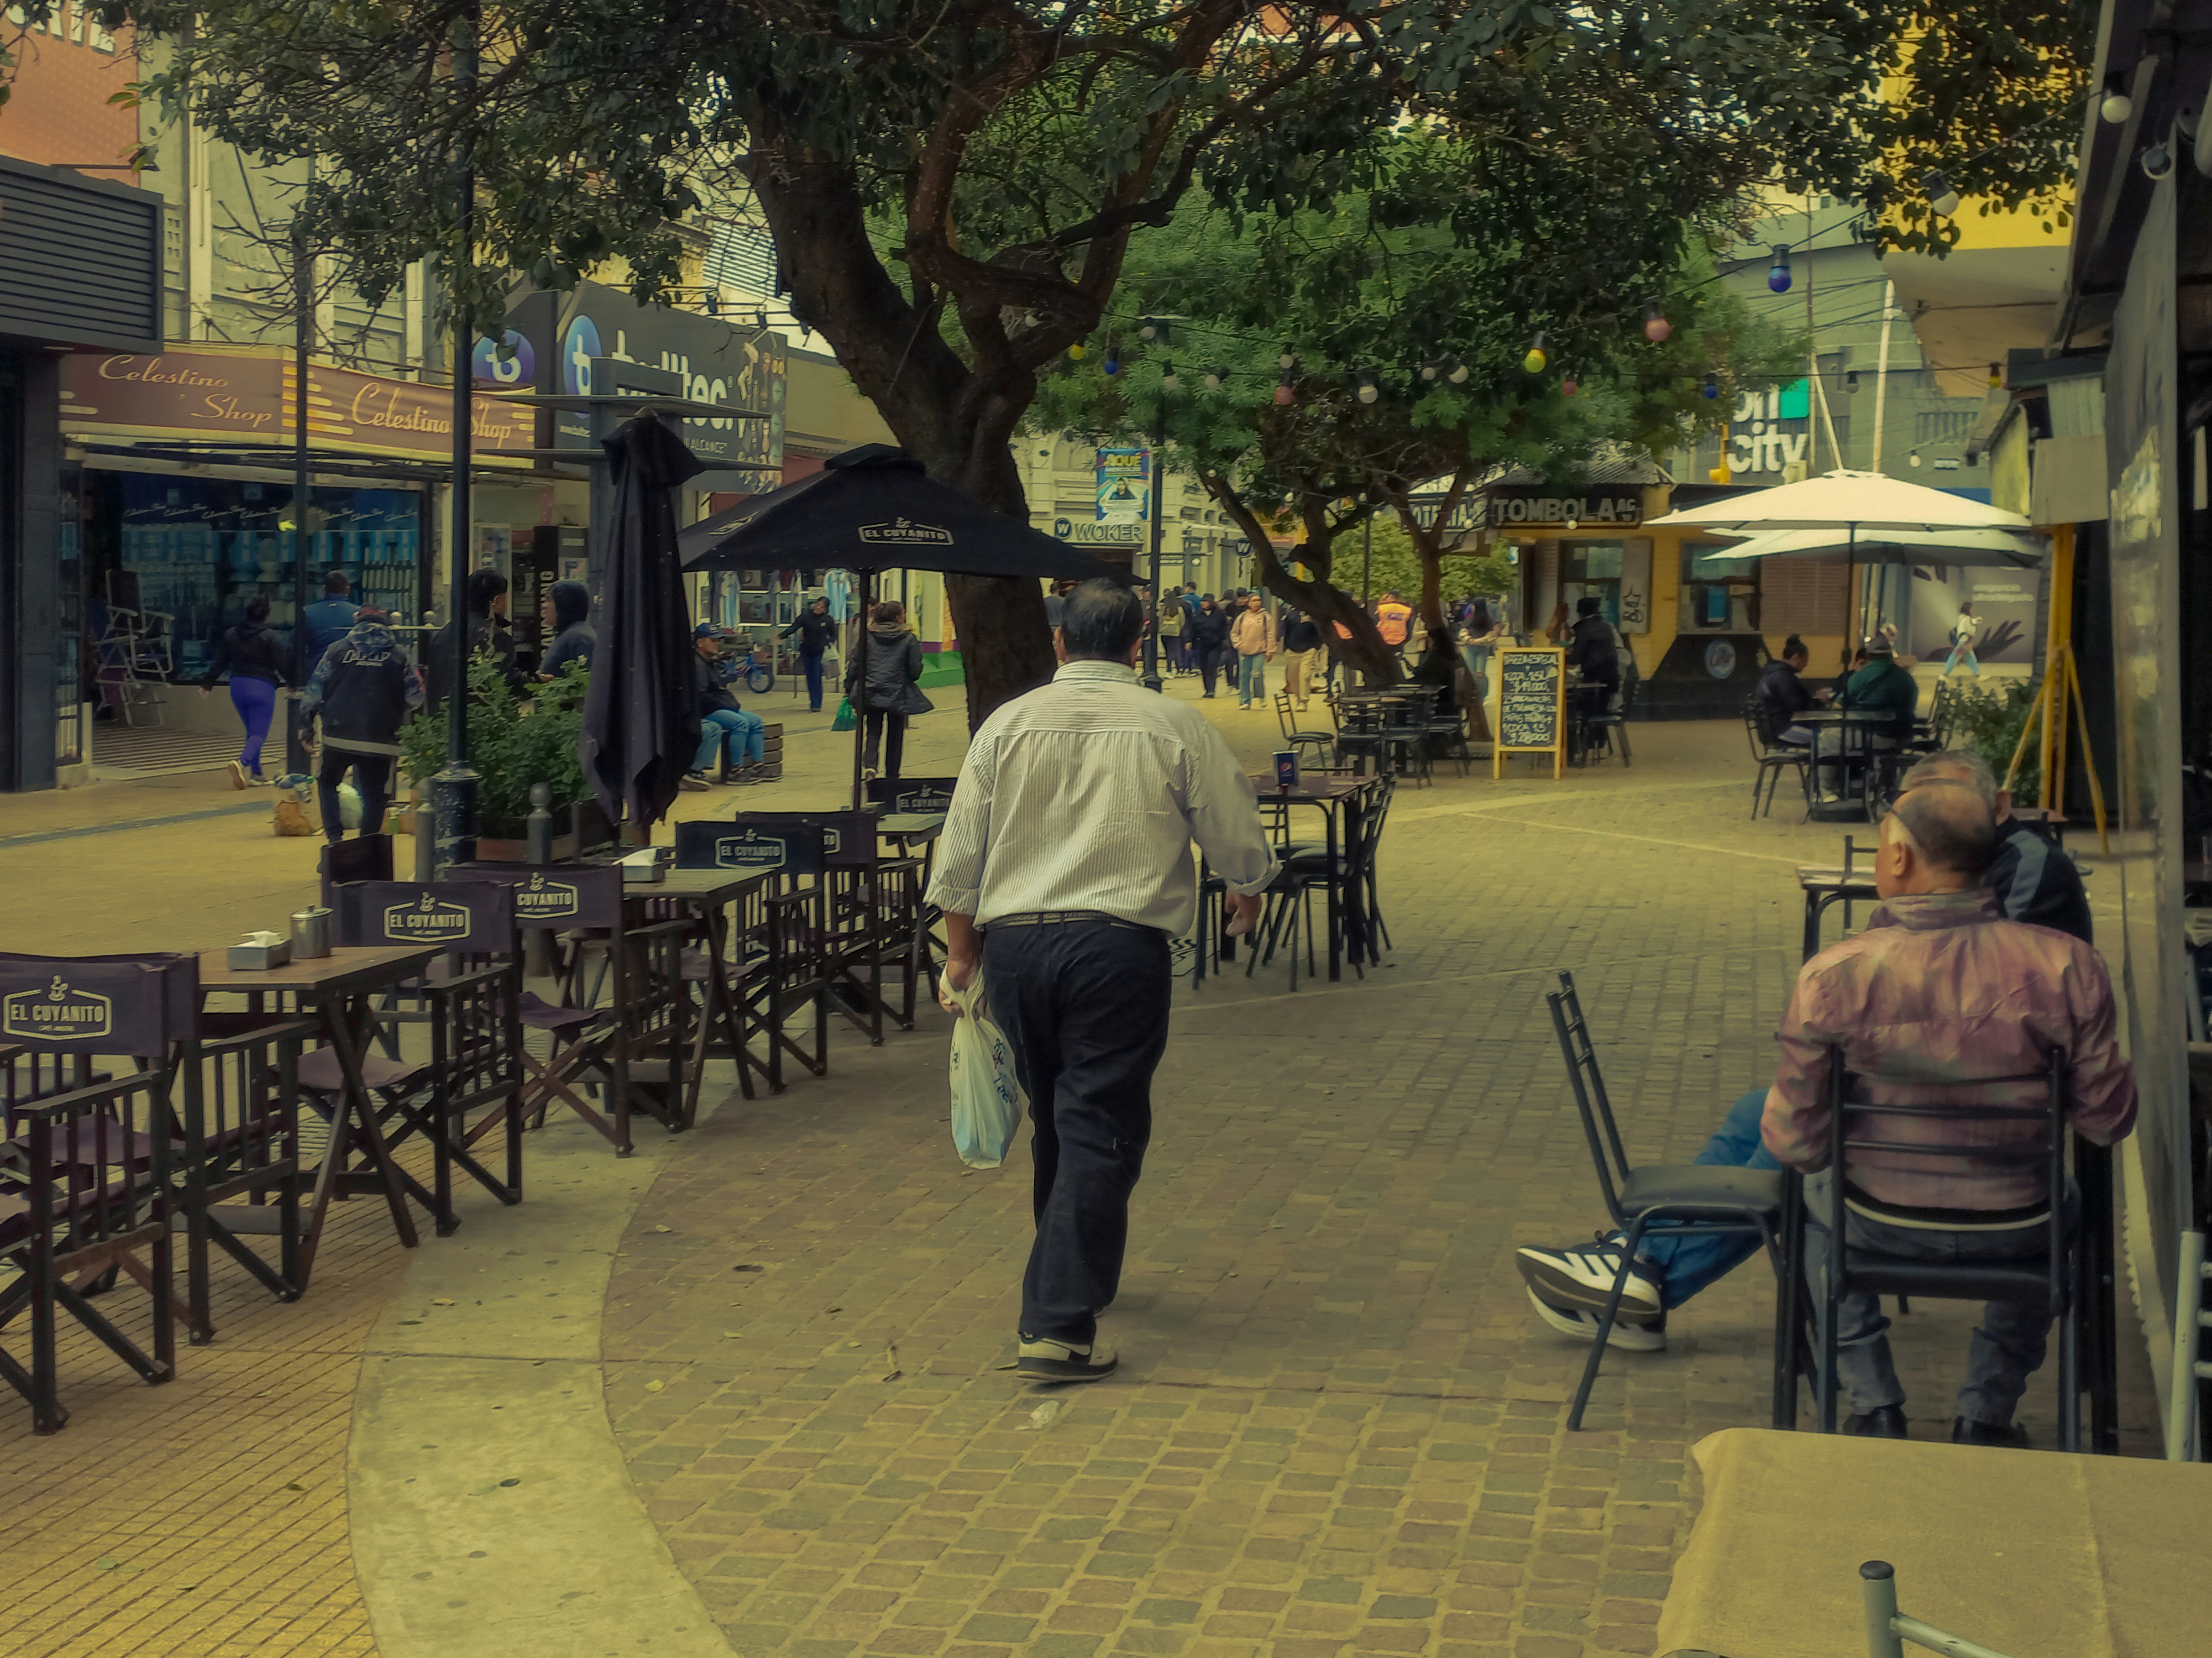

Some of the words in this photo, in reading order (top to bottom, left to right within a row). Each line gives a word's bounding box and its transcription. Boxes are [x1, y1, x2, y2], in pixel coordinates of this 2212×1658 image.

[98, 354, 229, 387] Celestino
[190, 393, 272, 428] Shop
[351, 382, 449, 434] Celestino
[1727, 421, 1808, 473] city
[1493, 498, 1617, 522] TOMBOLA
[865, 529, 881, 538] EL
[883, 529, 946, 540] CUYANITO
[1075, 523, 1145, 542] WOKER
[720, 845, 733, 856] EL
[735, 846, 780, 857] CUYANITO
[517, 892, 572, 906] CUYANITO
[390, 914, 405, 928] EL
[407, 914, 464, 928] CUYANITO
[10, 1004, 29, 1020] EL
[32, 1005, 104, 1022] CUYANITO
